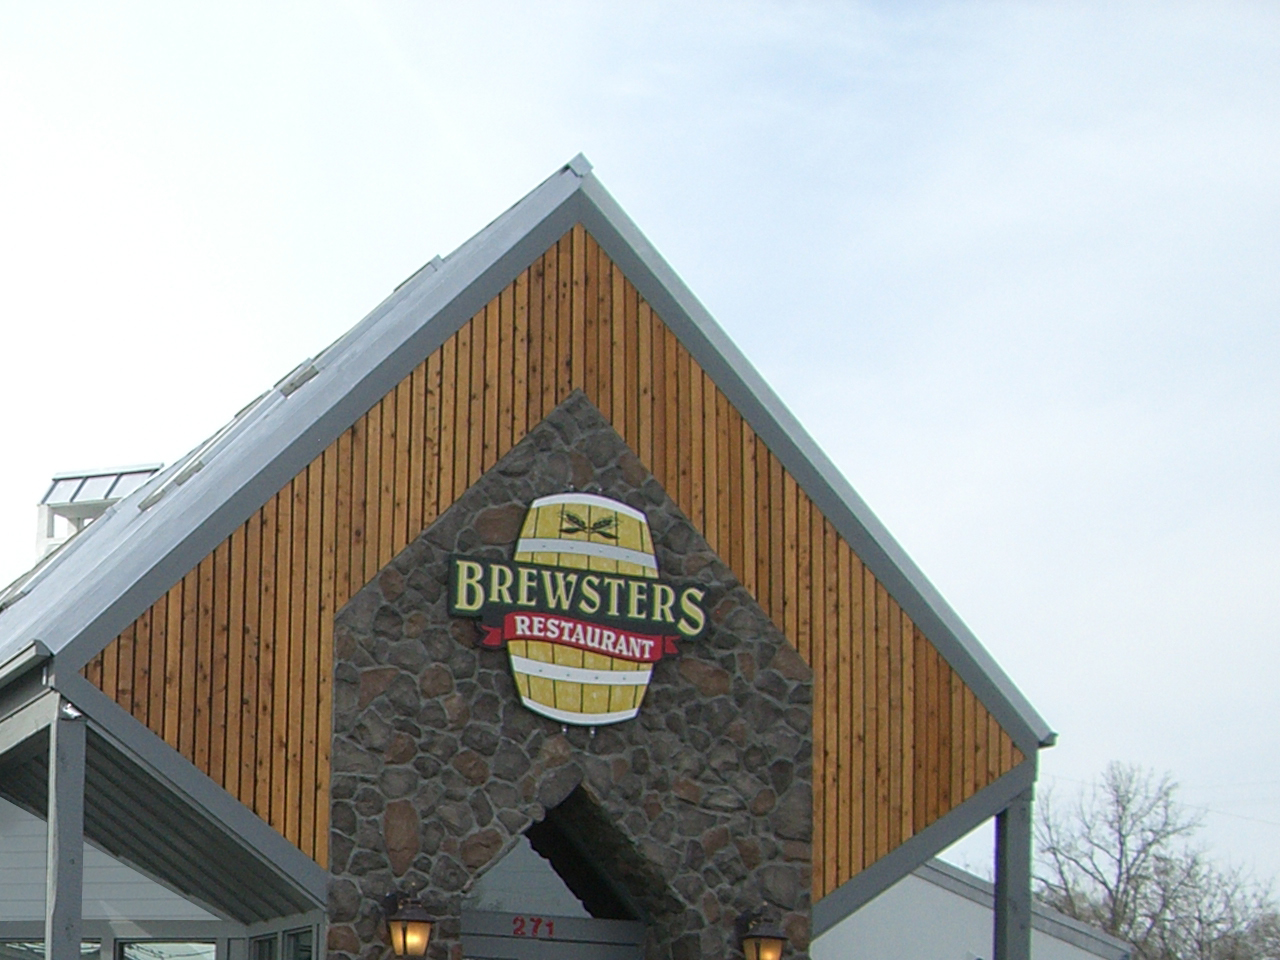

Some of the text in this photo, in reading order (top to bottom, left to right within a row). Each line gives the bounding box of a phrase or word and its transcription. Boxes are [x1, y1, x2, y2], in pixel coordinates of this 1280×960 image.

[455, 560, 705, 636] BREWSTERS
[514, 615, 654, 659] RESTAURANT
[512, 915, 554, 937] 271
